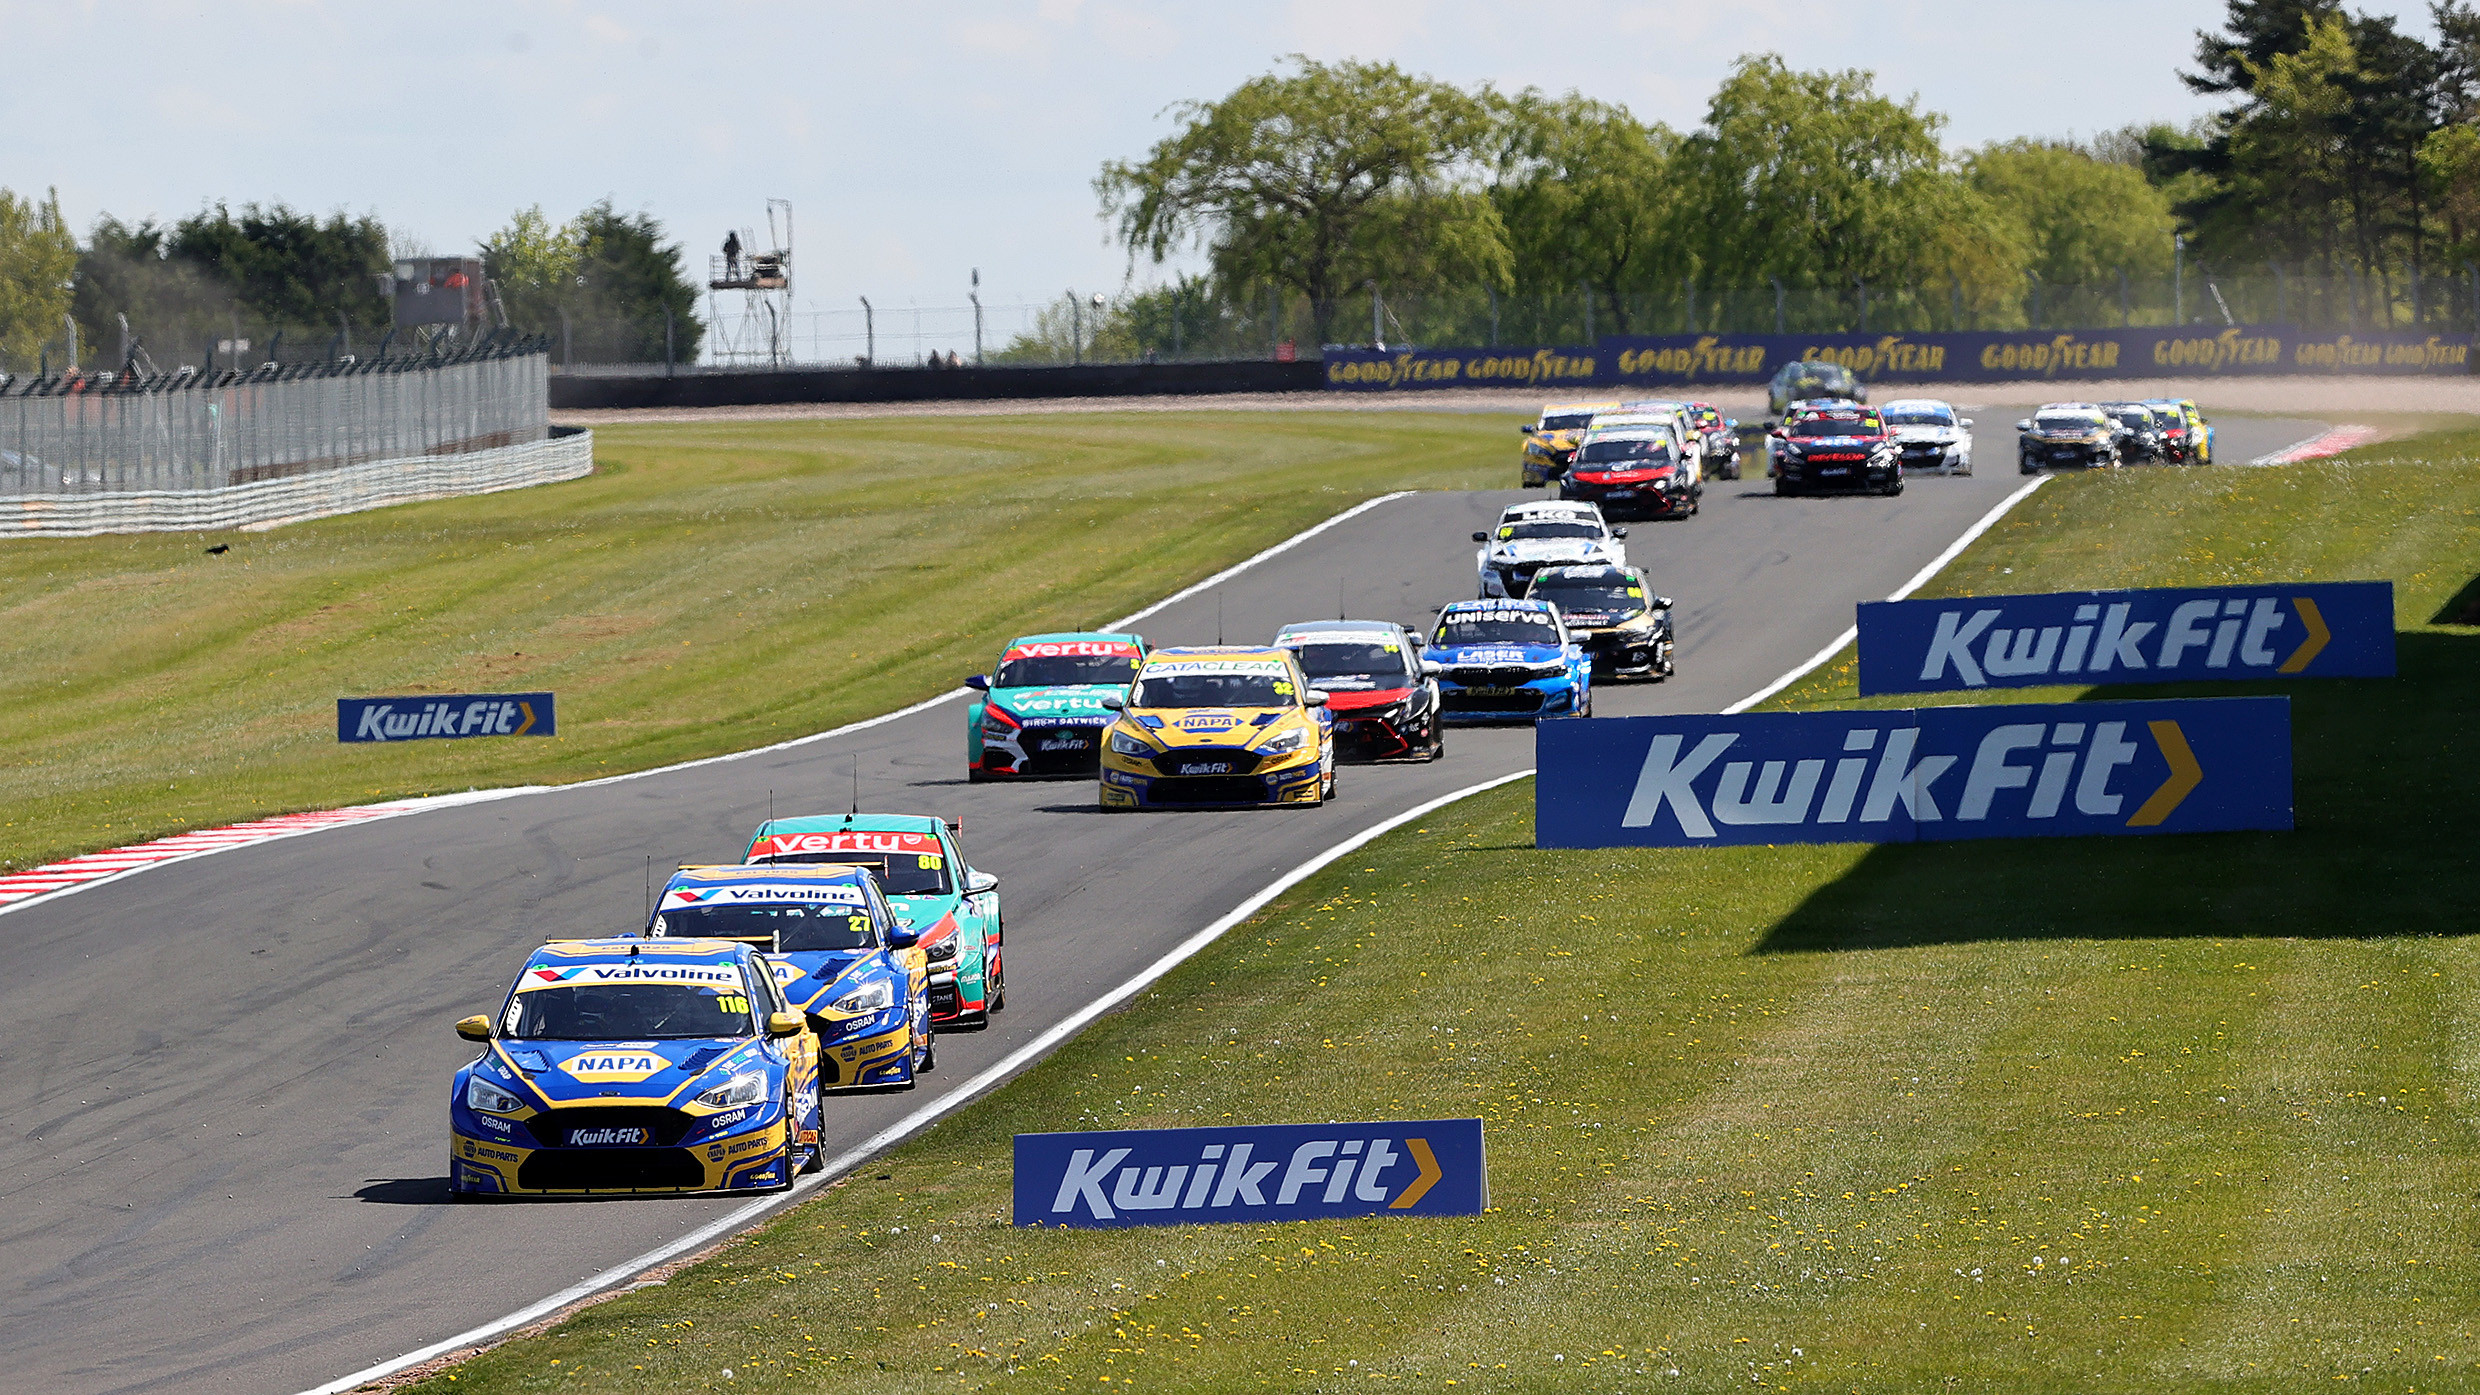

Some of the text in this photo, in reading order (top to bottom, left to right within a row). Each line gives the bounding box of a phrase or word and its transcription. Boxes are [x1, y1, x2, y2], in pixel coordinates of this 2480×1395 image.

[1618, 337, 1766, 380] GOODYEAR
[1130, 658, 1140, 670] 3
[1145, 661, 1283, 675] CATACLEAN
[1272, 681, 1295, 696] 32
[1183, 717, 1233, 727] NAPA
[918, 854, 942, 871] 80
[729, 887, 856, 901] Valvoline
[848, 916, 871, 932] 27
[594, 967, 733, 982] Valvoline
[715, 995, 750, 1014] 116
[845, 1014, 875, 1032] OSRAM
[577, 1057, 653, 1071] NAPA
[481, 1115, 511, 1134] OSRAM
[711, 1109, 746, 1128] OSRAM
[728, 1138, 768, 1156] AUTO PARTS
[477, 1148, 519, 1163] AUTO PARTS
